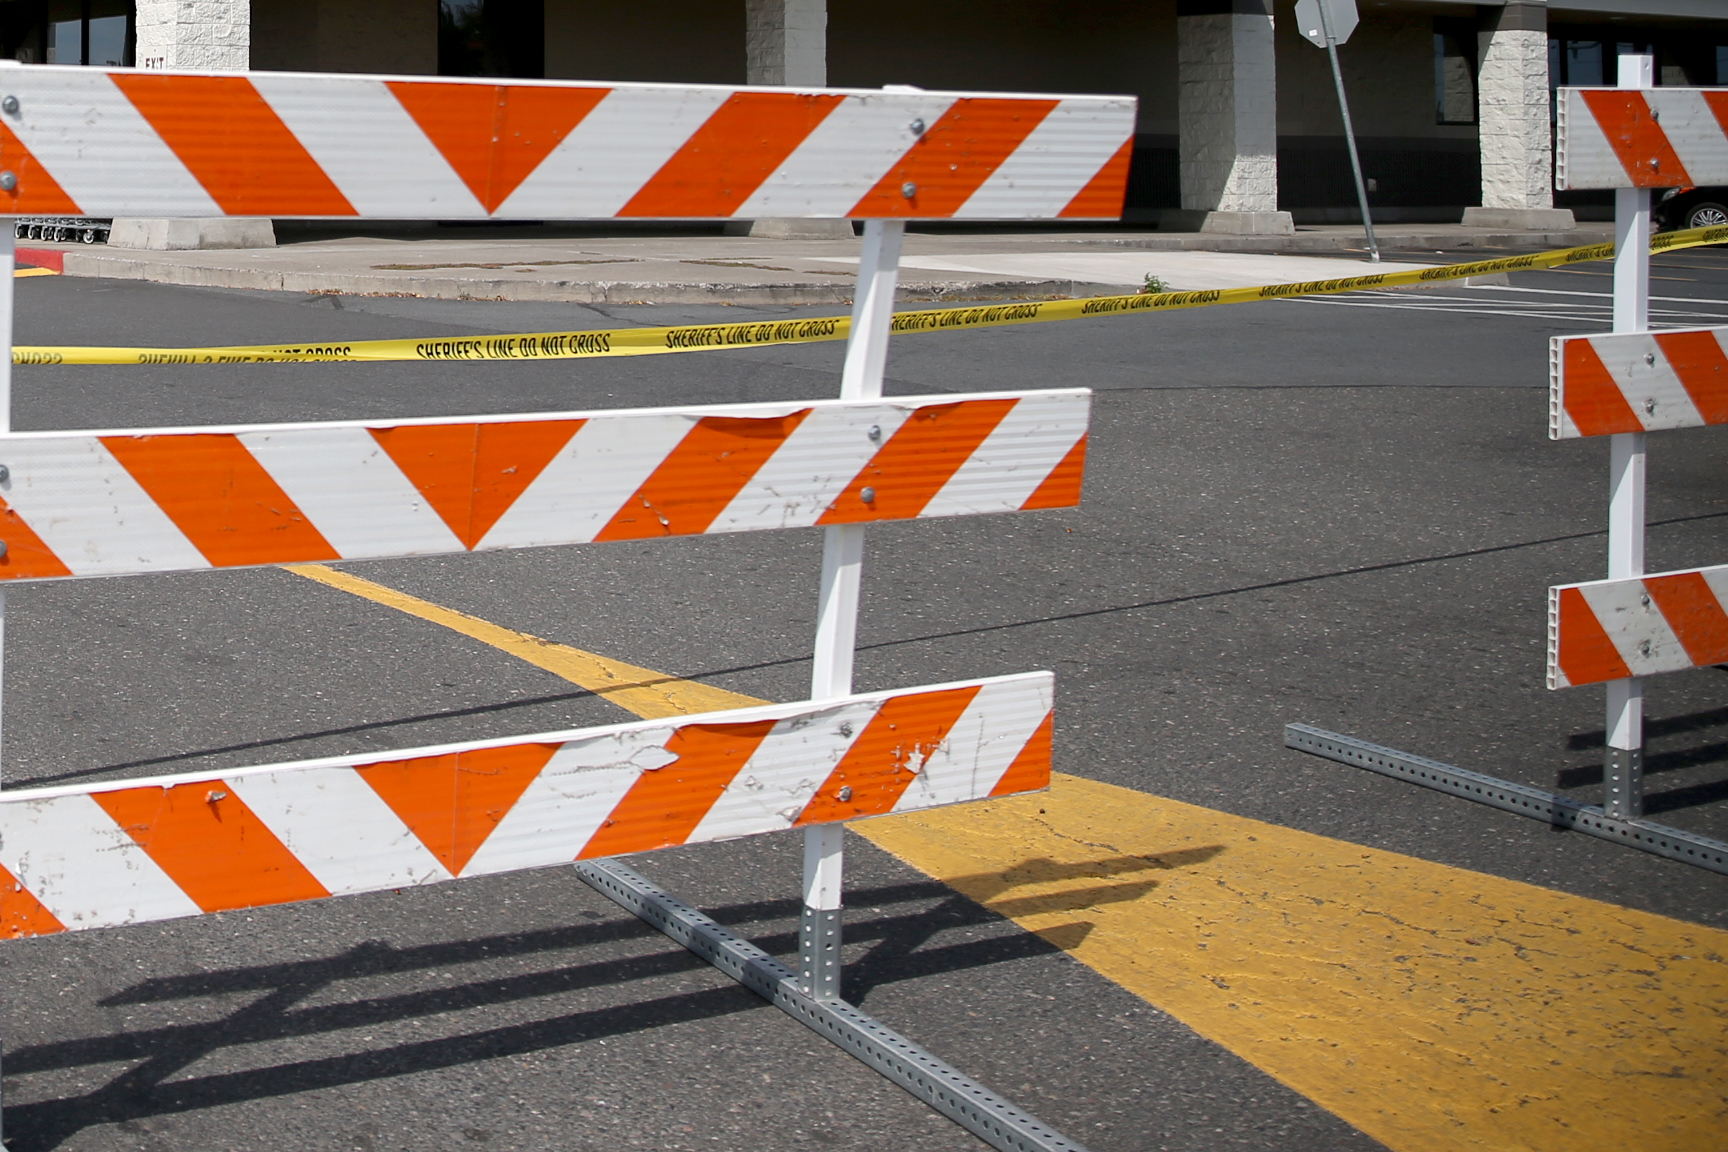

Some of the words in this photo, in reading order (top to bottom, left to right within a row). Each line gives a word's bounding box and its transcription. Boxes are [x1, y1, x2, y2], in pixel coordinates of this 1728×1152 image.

[939, 309, 968, 327] LINE
[965, 308, 984, 324] DO
[982, 306, 1008, 323] NOT
[1005, 303, 1042, 320] CROSS
[417, 340, 484, 359] SHERIFF'S
[486, 338, 517, 358] LINE
[519, 337, 538, 357] DO
[541, 335, 567, 355] NOT
[569, 333, 611, 354] CROSS
[666, 327, 725, 349] SHERIFF'S
[726, 325, 756, 344] LINE
[756, 324, 774, 342] DO
[775, 321, 802, 340] NOT
[799, 319, 840, 338] CROSS
